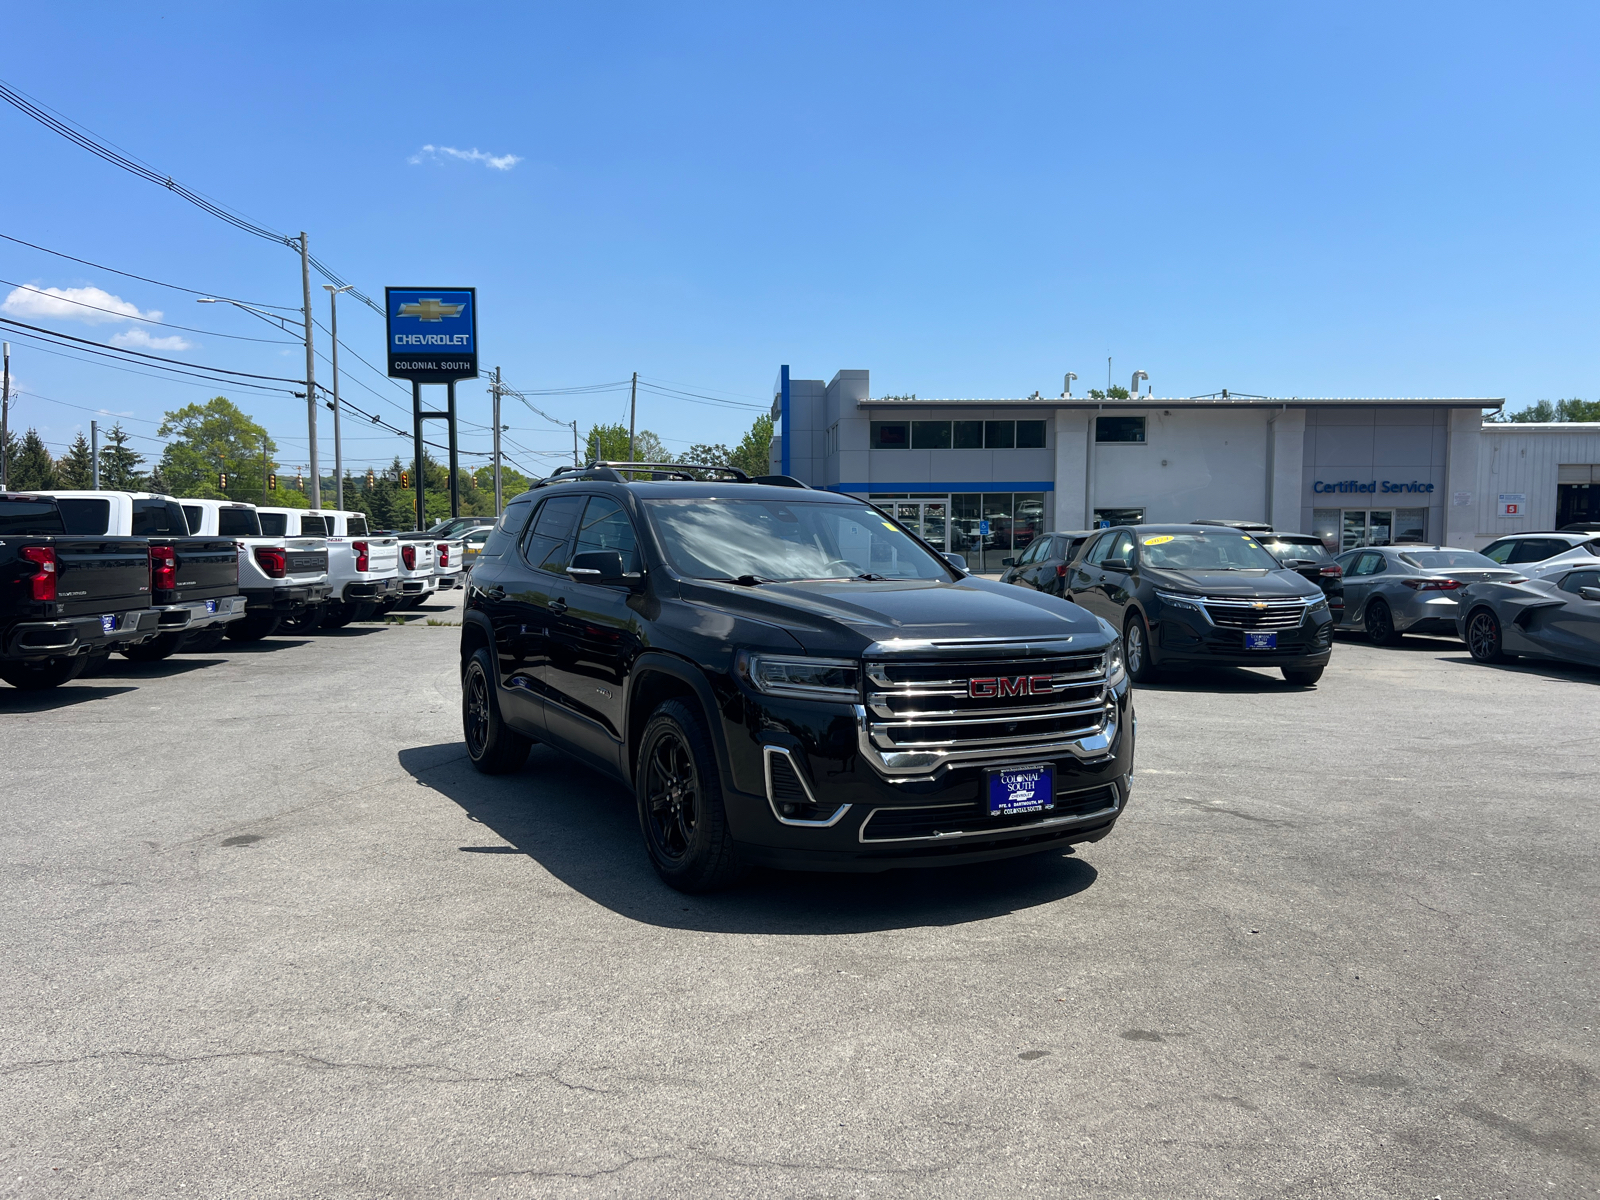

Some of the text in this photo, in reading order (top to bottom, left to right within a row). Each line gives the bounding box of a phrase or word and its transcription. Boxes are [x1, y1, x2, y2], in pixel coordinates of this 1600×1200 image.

[395, 334, 469, 345] CHEVROLET
[395, 361, 470, 370] COLONIAL SOUTH
[1313, 480, 1435, 493] Certified Service
[1508, 505, 1515, 513] 5
[292, 557, 326, 567] FORD
[969, 675, 1053, 698] GMC
[1001, 772, 1041, 784] COLONIAL
[1007, 781, 1035, 792] SOUTH
